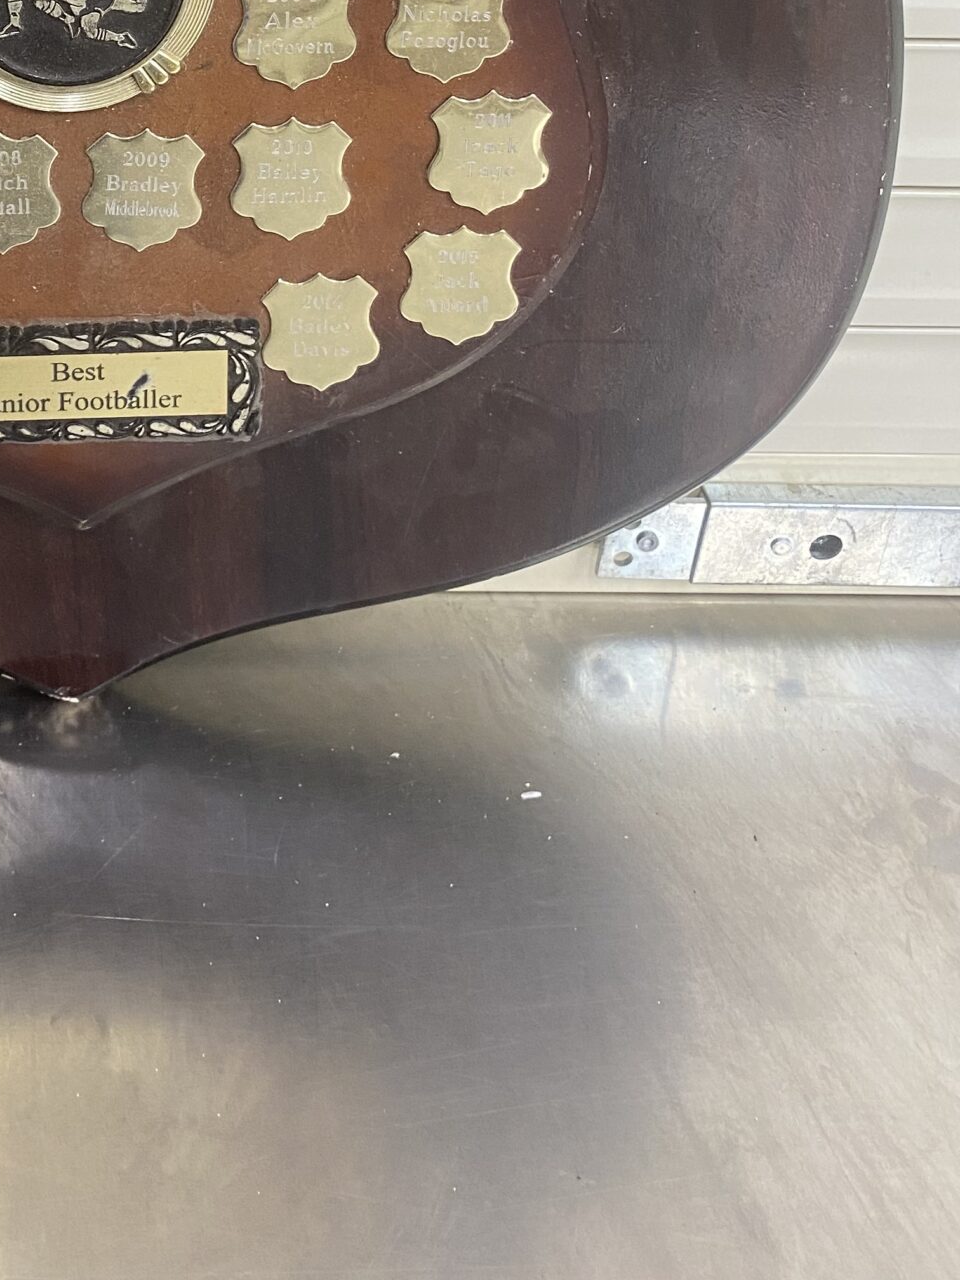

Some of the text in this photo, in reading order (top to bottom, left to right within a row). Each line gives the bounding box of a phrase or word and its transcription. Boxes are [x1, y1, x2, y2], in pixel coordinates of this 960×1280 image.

[264, 12, 318, 30] Alex
[403, 4, 492, 24] Nicholas
[246, 38, 335, 56] McGovern
[122, 151, 171, 168] 2009
[257, 163, 321, 184] Bailey
[105, 174, 181, 196] Bradley
[104, 200, 180, 218] Middlebrook
[50, 362, 105, 383] Best
[57, 389, 182, 413] Footballer
